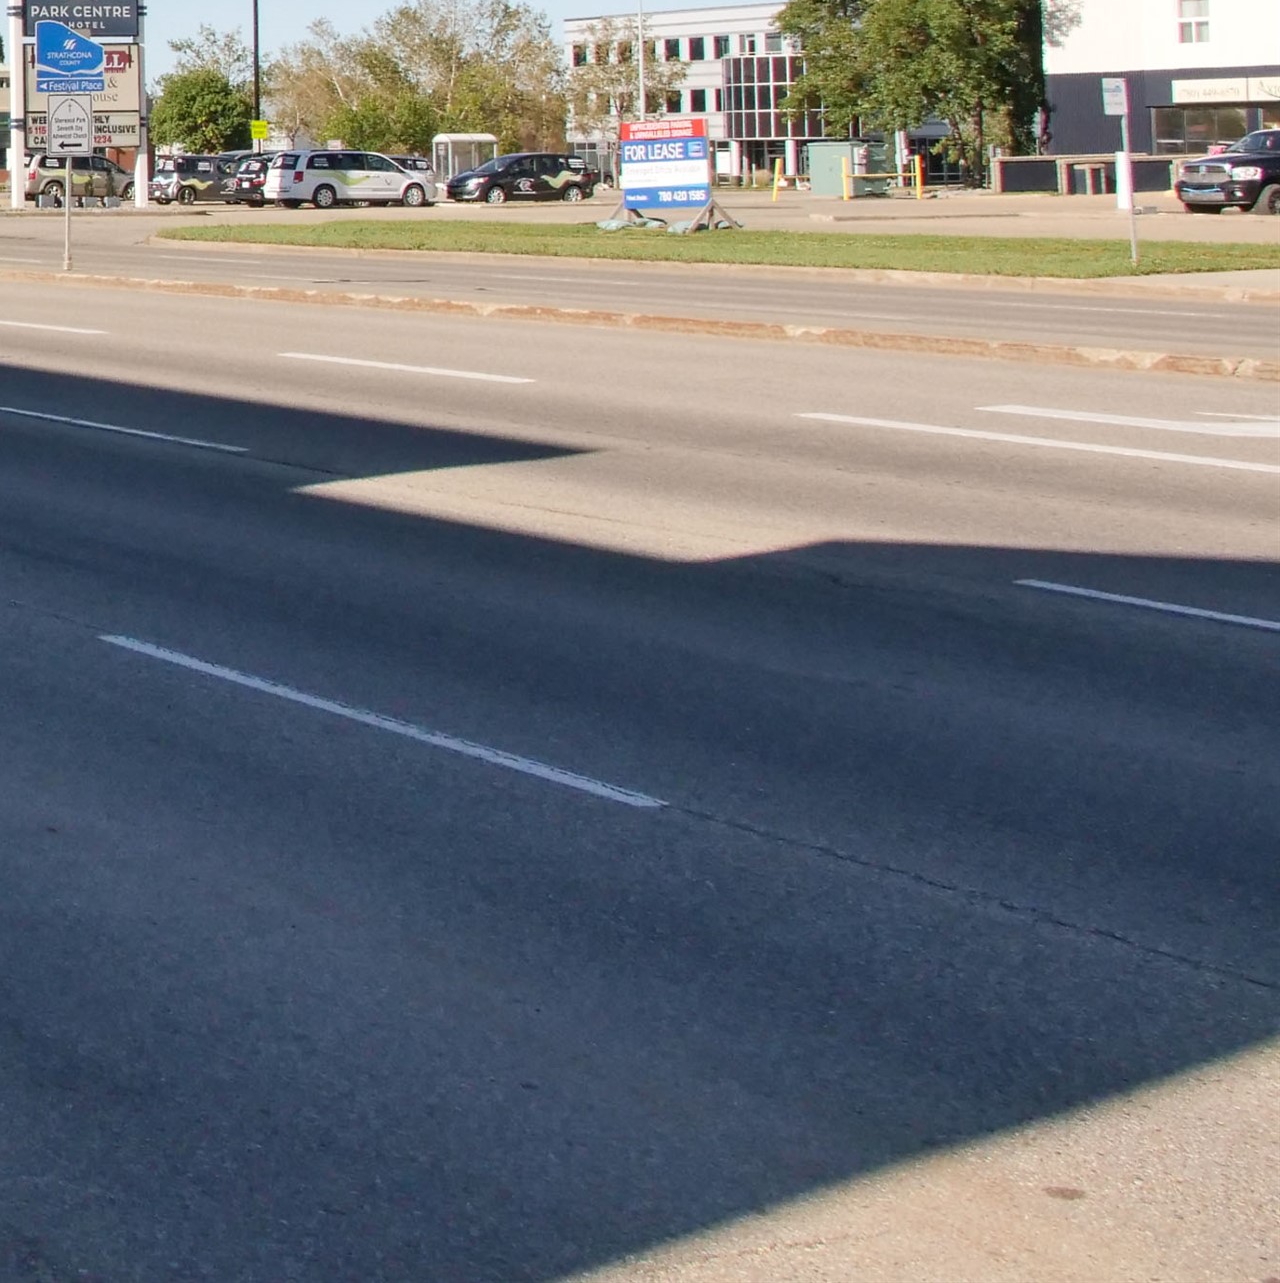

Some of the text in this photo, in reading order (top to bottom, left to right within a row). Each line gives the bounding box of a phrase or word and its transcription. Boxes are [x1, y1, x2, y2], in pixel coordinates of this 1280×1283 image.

[30, 5, 131, 18] PARK CENTRE
[68, 21, 106, 29] HOTEL
[46, 51, 93, 59] STRATHCONA
[48, 80, 103, 91] Festival Place
[107, 76, 119, 89] &
[93, 92, 119, 102] ouse
[93, 124, 137, 134] INCLUSIVE
[33, 136, 47, 145] CA
[624, 144, 647, 161] FOR
[647, 141, 685, 160] LEASE
[673, 190, 687, 202] 420
